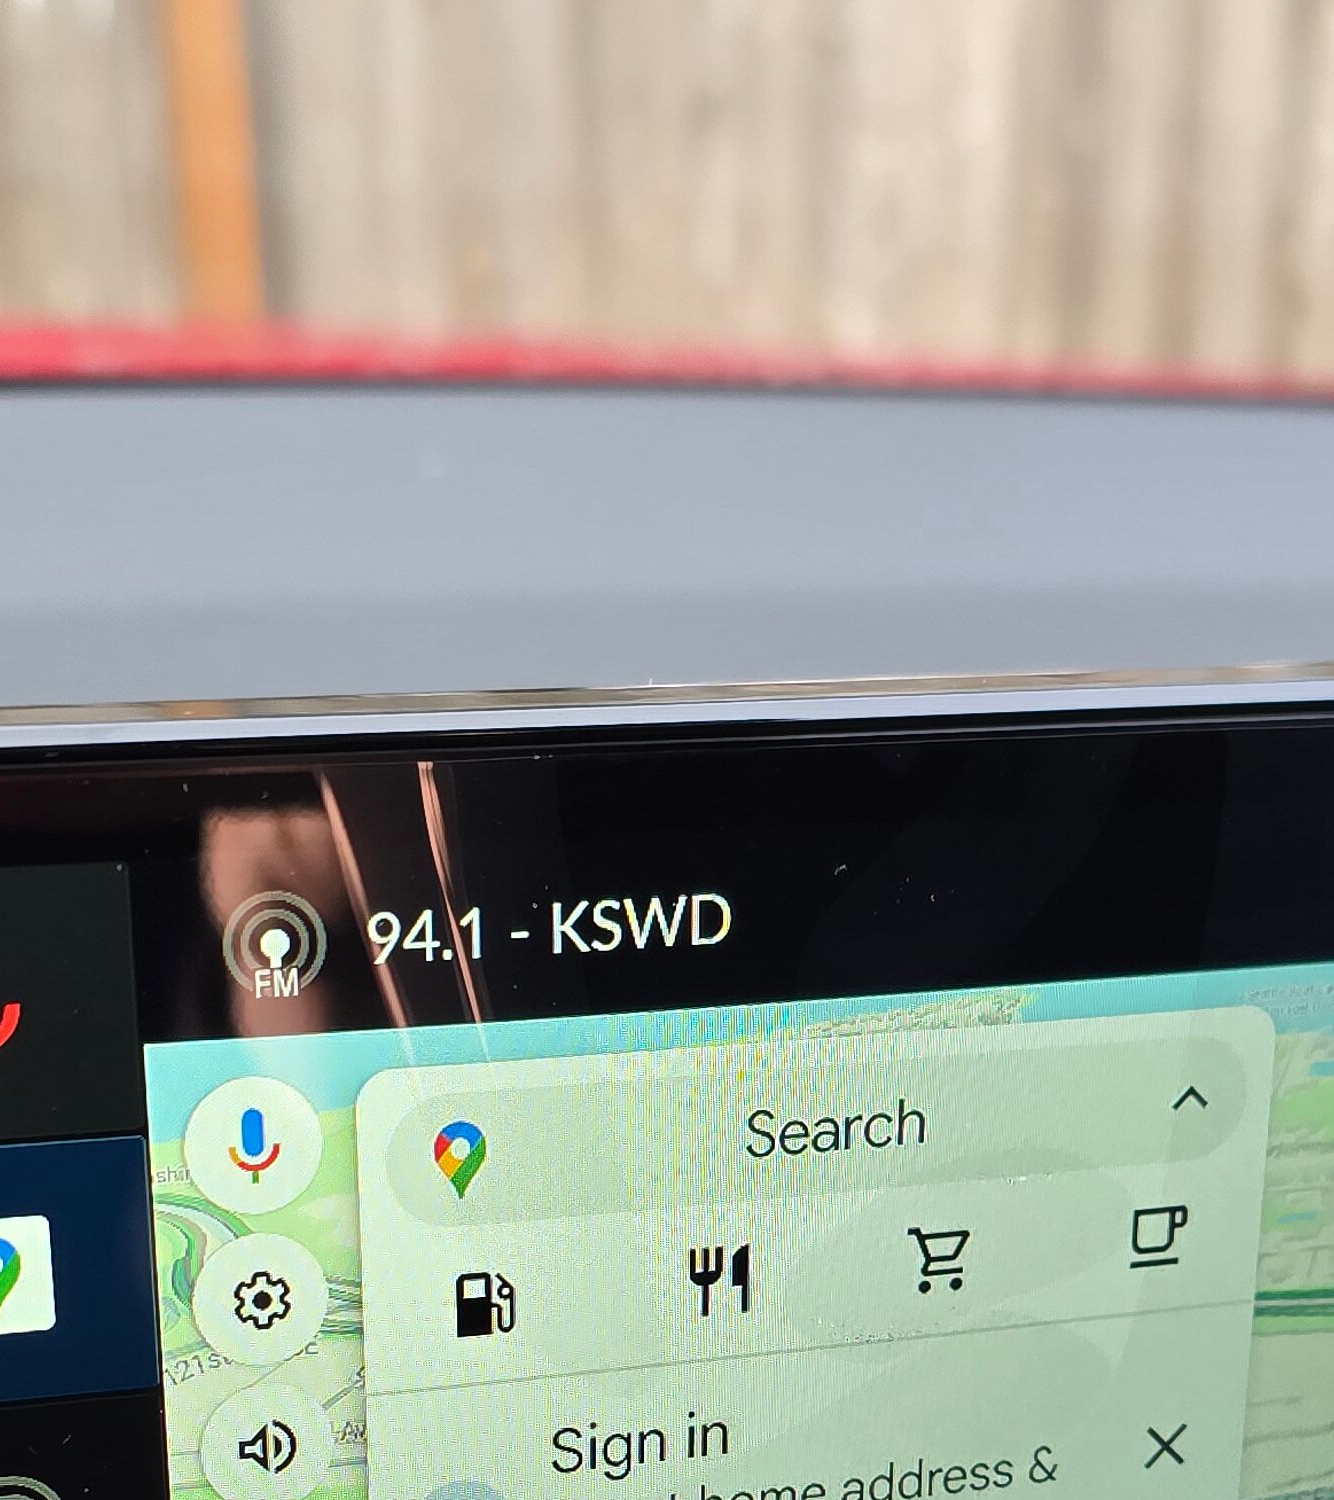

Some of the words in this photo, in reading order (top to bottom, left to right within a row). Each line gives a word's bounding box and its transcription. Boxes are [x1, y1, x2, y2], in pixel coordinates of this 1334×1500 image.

[367, 908, 482, 964] 94.1
[510, 930, 530, 940] -
[552, 892, 733, 955] KSWD
[254, 967, 299, 998] FM
[745, 1098, 926, 1158] Search
[551, 1424, 667, 1481] Sign
[687, 1411, 729, 1459] in
[1028, 1445, 1058, 1484] &
